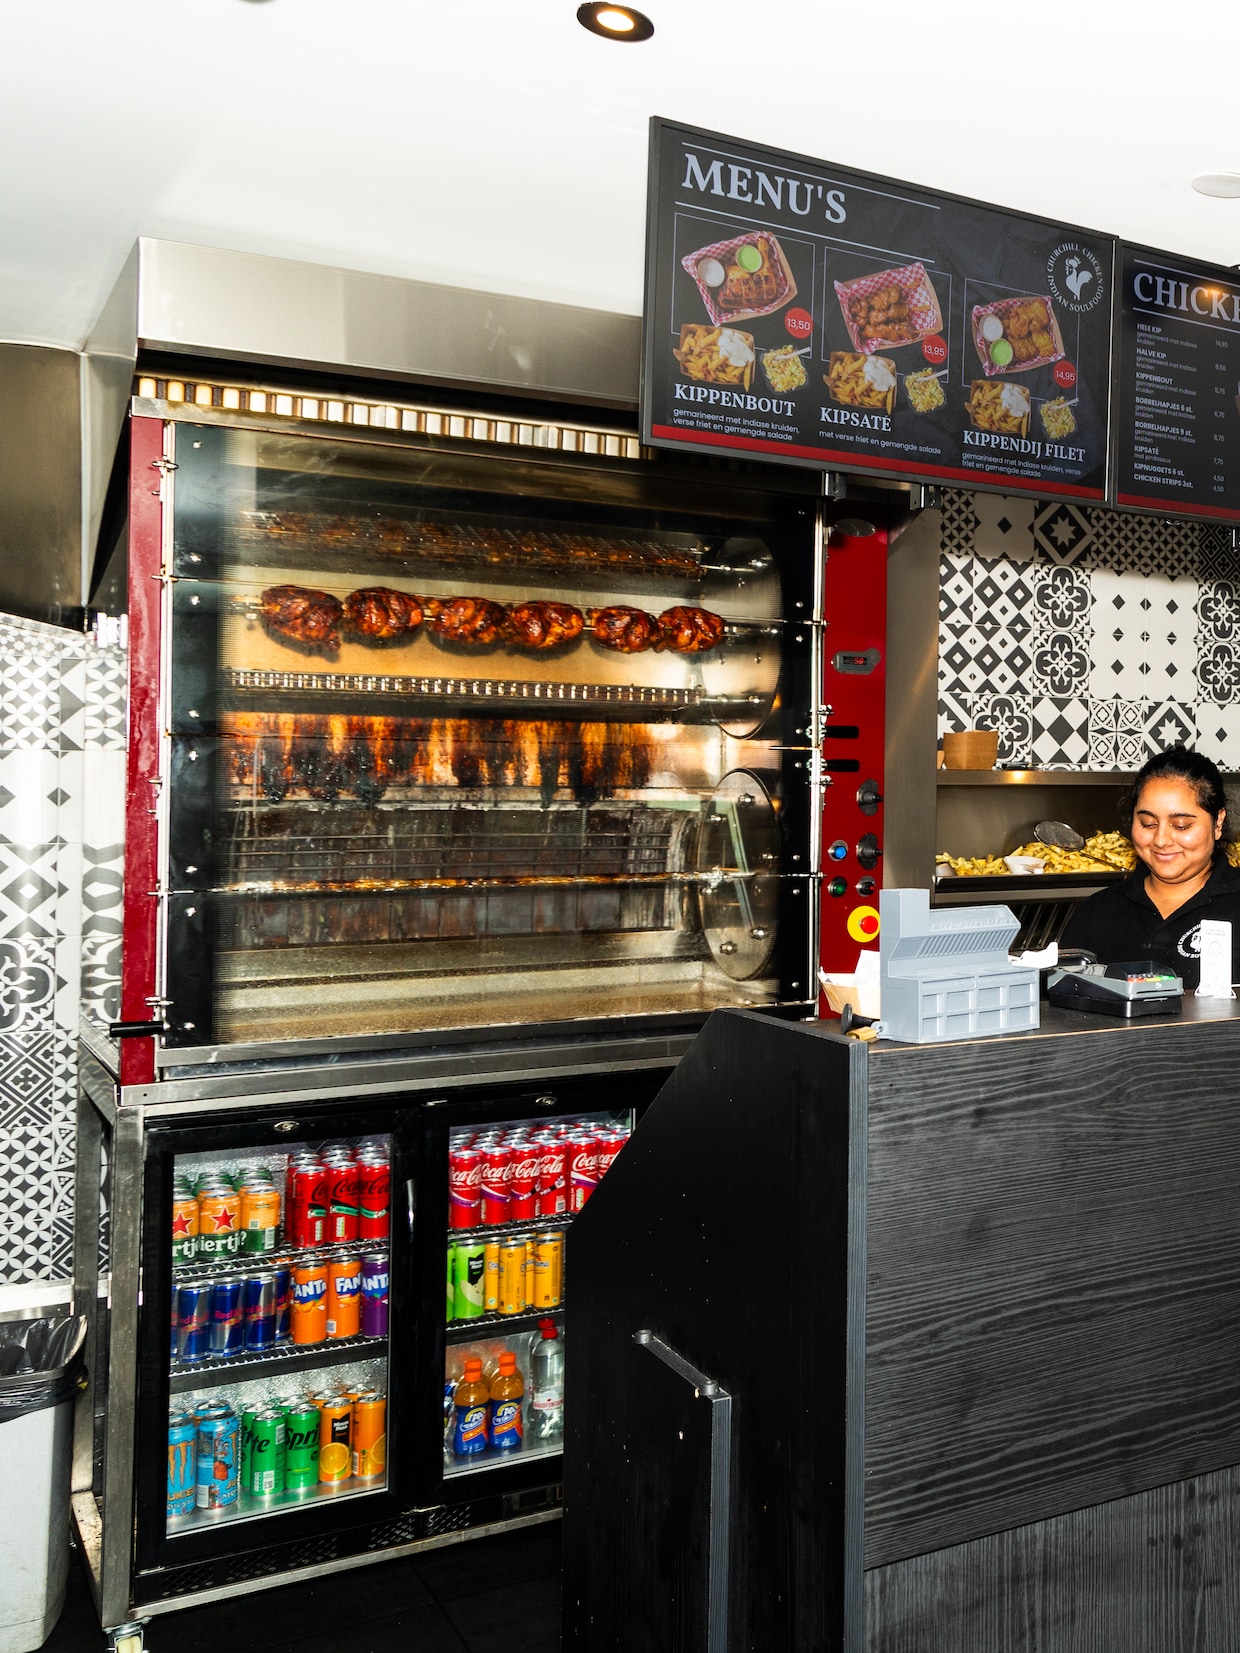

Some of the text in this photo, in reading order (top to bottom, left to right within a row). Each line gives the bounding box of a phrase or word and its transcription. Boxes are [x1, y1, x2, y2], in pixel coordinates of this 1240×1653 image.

[682, 153, 846, 223] MENU'S
[1047, 243, 1103, 284] CHURCHILL CHICKEN
[1047, 275, 1104, 312] INDIAN SOULFOOD
[787, 318, 811, 331] 13,50
[1137, 323, 1162, 333] HELE KIP
[923, 343, 945, 356] 13,95
[1136, 347, 1167, 359] HALVE KIP
[1055, 370, 1076, 381] 14,95
[1135, 371, 1173, 385] KIPPENBOUT
[674, 383, 796, 417] KIPPENBOUT
[1135, 396, 1180, 411] BORRELHAPJES
[673, 408, 800, 434] gemarineerd met Indiase kruiden,
[820, 406, 892, 432] KIPSATÉ
[1135, 420, 1179, 435] BORRELHAPJES
[673, 417, 793, 441] verse friet en gemengde salade
[818, 430, 942, 455] met verse friet en gemengde salade
[963, 430, 1086, 462] KIPPENDIJ FILET
[962, 452, 1081, 476] gemarineerd met Indiase kruiden, verse
[962, 460, 1041, 478] friet en gemengde salade
[1134, 462, 1172, 475] KIPNUGGETS
[1134, 473, 1161, 484] CHICKEN
[1162, 477, 1182, 487] STRIPS
